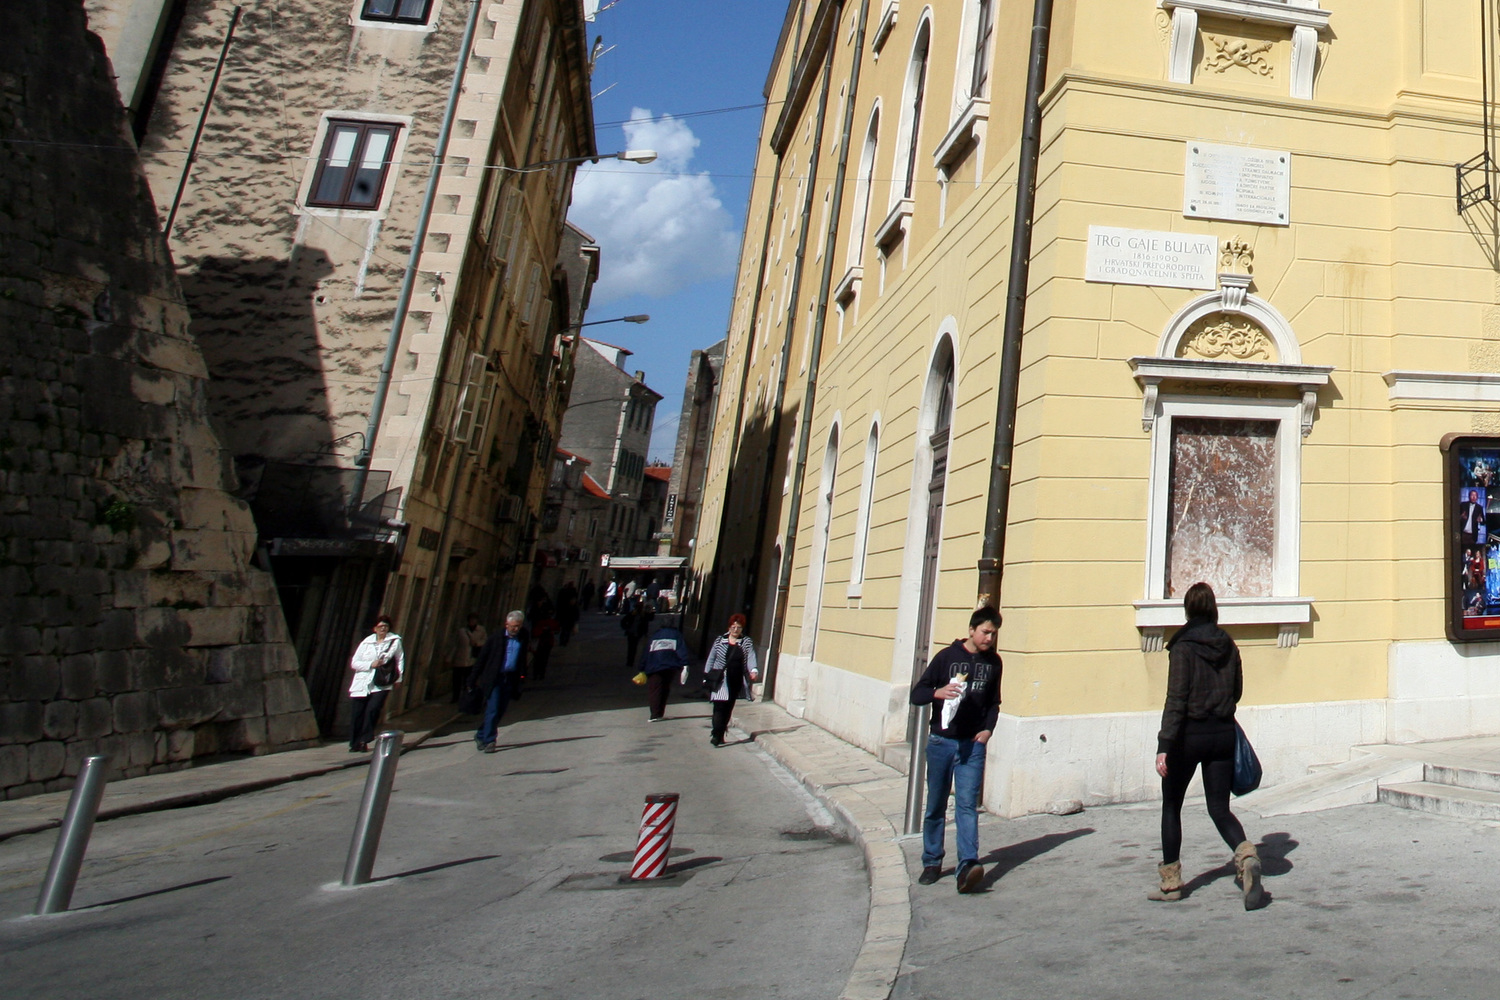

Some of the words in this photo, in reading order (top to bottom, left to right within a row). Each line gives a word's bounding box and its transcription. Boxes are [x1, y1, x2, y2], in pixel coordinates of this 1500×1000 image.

[1095, 234, 1120, 248] TRG
[1128, 237, 1158, 252] GAJE
[1164, 240, 1212, 255] BULATA
[1104, 258, 1139, 268] HRVATSKI
